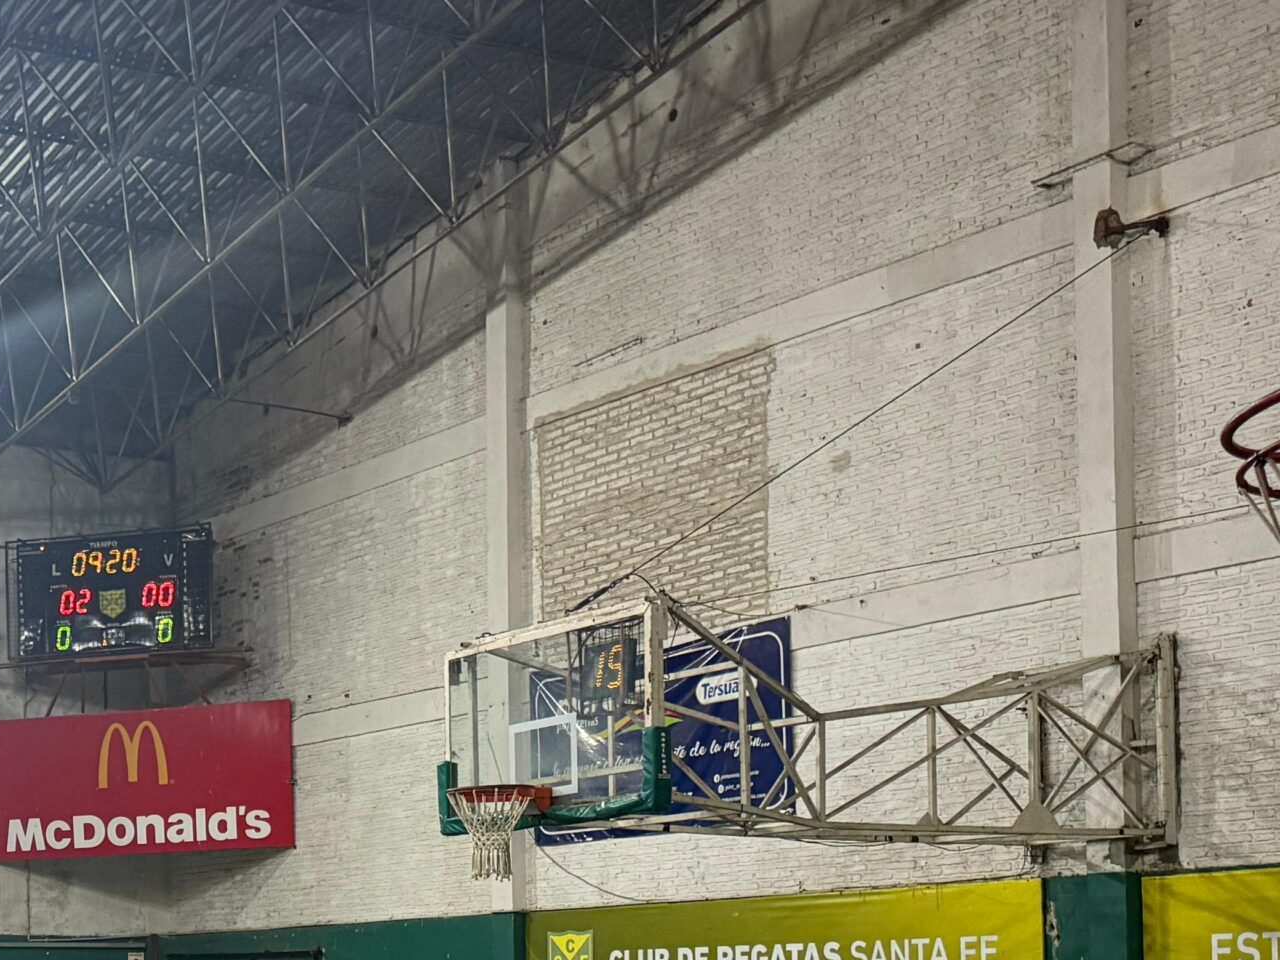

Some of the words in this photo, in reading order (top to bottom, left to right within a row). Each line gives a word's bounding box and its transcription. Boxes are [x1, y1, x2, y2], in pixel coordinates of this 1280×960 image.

[163, 553, 174, 566] V
[59, 588, 92, 616] 02
[141, 581, 175, 608] 00
[55, 625, 71, 651] 0
[701, 680, 740, 700] Tersua
[6, 806, 272, 853] McDonald's
[565, 938, 576, 954] C
